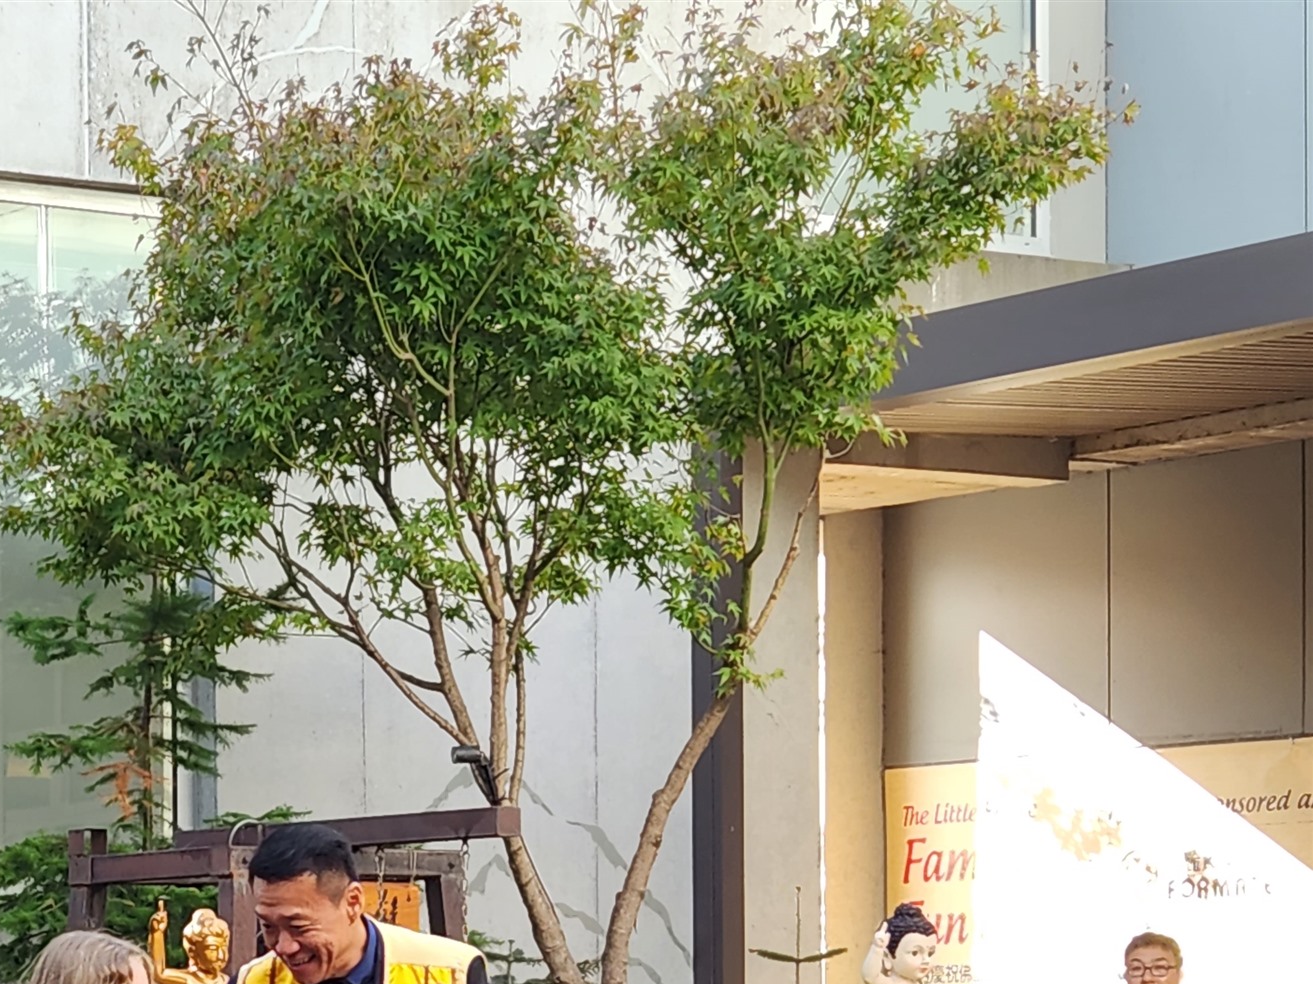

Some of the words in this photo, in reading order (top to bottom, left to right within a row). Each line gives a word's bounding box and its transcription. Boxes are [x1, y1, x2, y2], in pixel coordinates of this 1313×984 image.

[1217, 789, 1292, 814] nsored
[902, 805, 929, 827] The
[934, 802, 977, 824] Little
[902, 837, 976, 884] Fam
[910, 900, 969, 945] un
[925, 964, 974, 984] 慶祝佛
